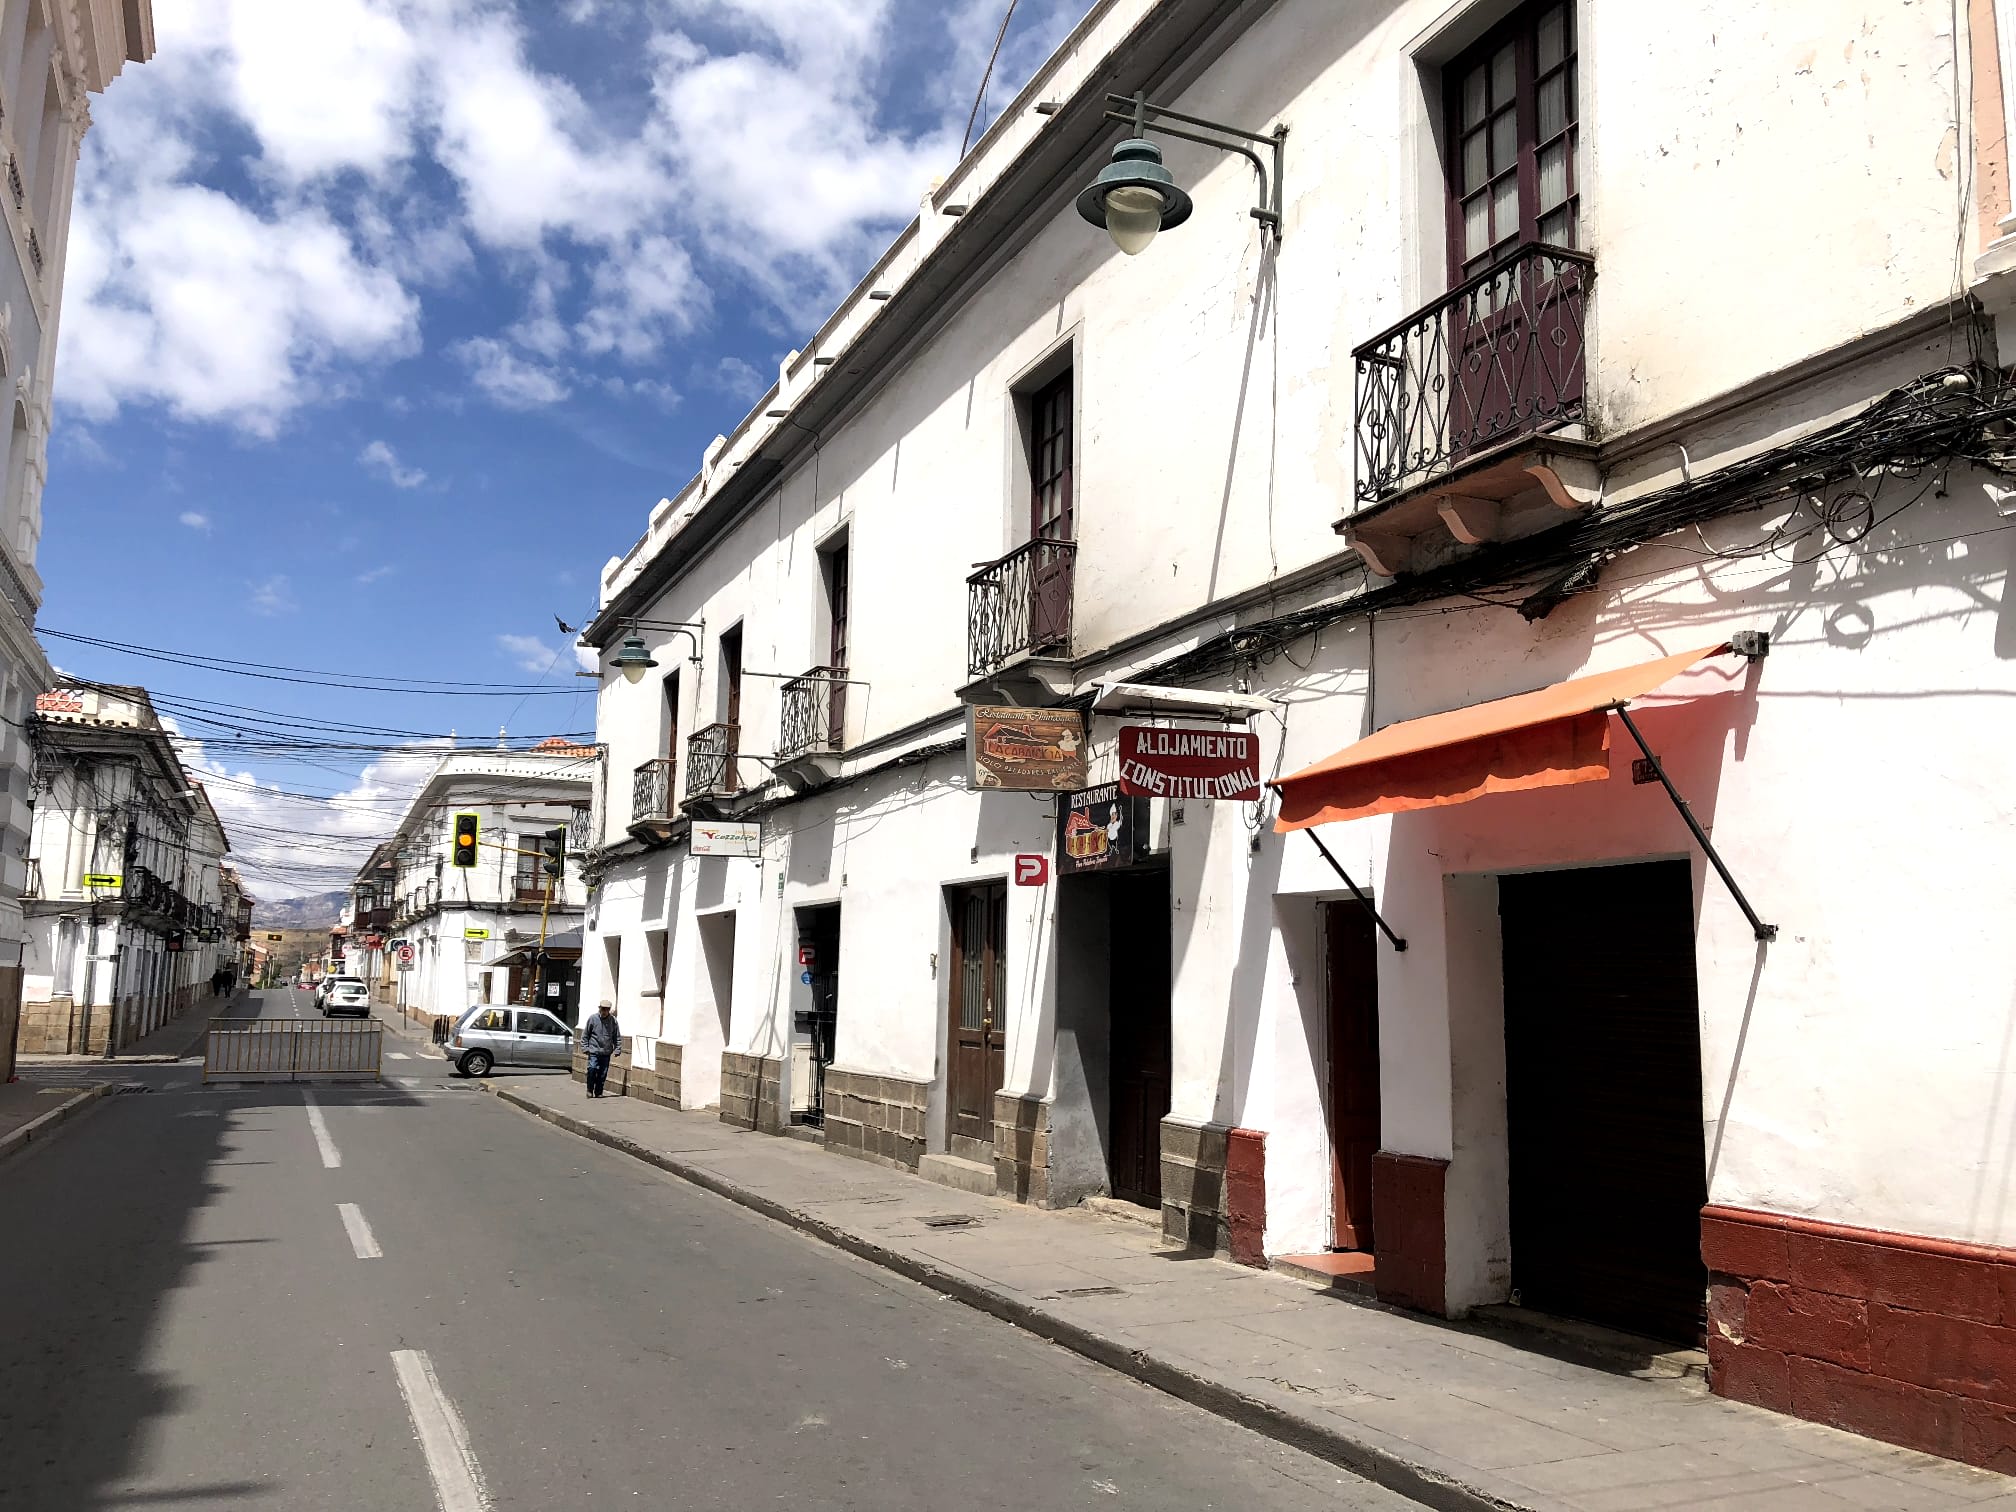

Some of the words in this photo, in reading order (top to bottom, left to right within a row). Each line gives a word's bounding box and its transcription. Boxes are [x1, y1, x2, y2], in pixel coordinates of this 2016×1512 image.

[1136, 731, 1247, 759] ALOJAMIENTO
[979, 756, 1002, 769] SOLO
[1120, 758, 1260, 799] CONSTITUCIONAL
[1071, 785, 1118, 809] RESTAURANTE
[1018, 858, 1042, 883] P
